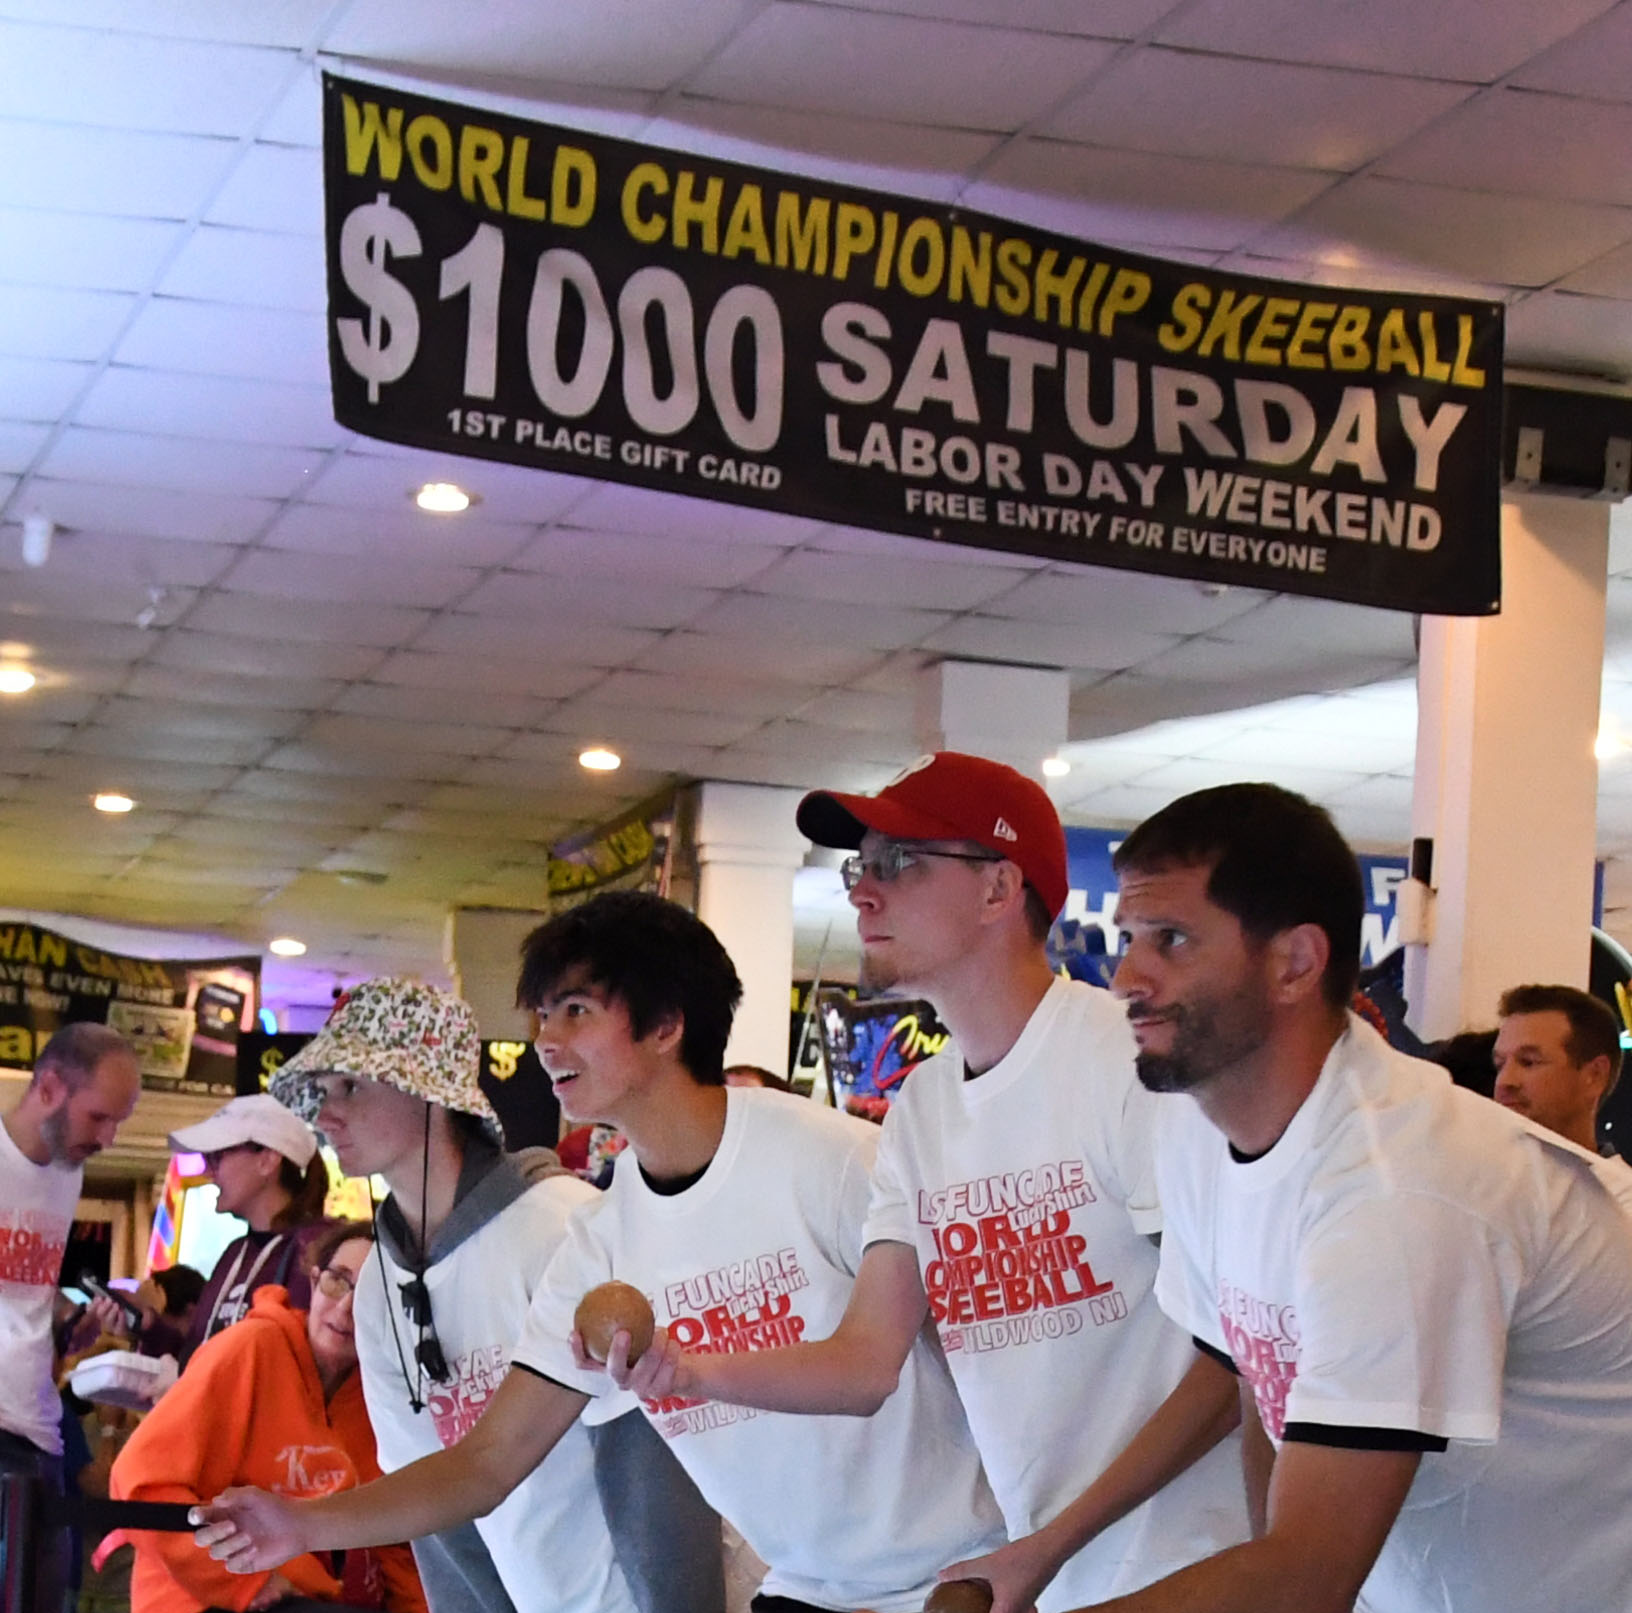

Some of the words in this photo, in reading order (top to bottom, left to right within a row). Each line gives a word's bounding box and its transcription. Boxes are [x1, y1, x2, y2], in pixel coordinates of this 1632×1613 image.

[342, 94, 597, 228] WORLD
[621, 163, 1151, 337] CHAMPIONSHIP
[1158, 283, 1485, 389] SKEEBALL
[336, 192, 784, 453] $1000
[816, 301, 1468, 493] SATURDAY
[448, 409, 506, 440] 1ST
[515, 421, 612, 459] PLACE
[621, 440, 691, 474] GIFT
[698, 455, 782, 490] CARD
[825, 415, 1024, 492] LABOR
[1043, 452, 1167, 507] DAY
[1184, 467, 1442, 553] WEEKEND
[906, 487, 987, 523] FREE
[997, 500, 1104, 537] ENTRY
[1109, 517, 1165, 548] FOR
[1171, 528, 1327, 573] EVERYONE
[665, 1246, 800, 1319] FUNCADE
[1088, 1291, 1129, 1327] NJ
